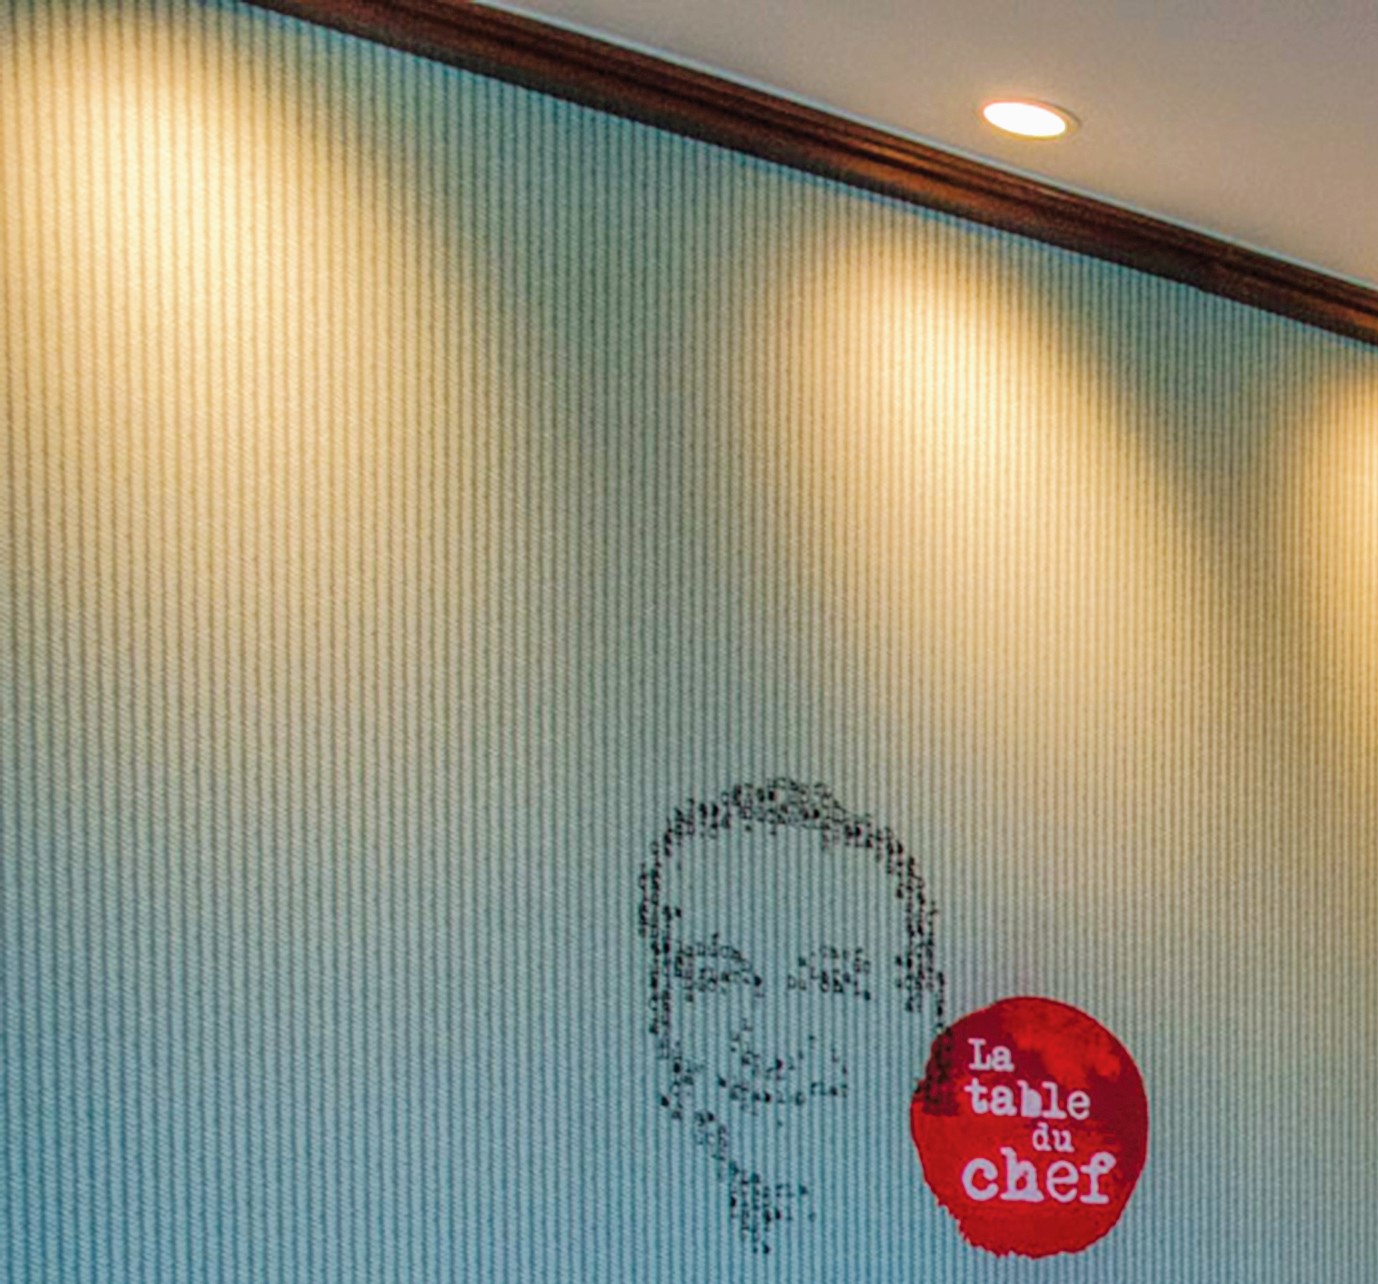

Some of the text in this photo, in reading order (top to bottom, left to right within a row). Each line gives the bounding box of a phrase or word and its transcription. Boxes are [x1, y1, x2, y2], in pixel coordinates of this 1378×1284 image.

[967, 1037, 1015, 1072] La
[963, 1077, 1091, 1120] table
[1032, 1121, 1075, 1152] du
[961, 1146, 1117, 1204] chef
